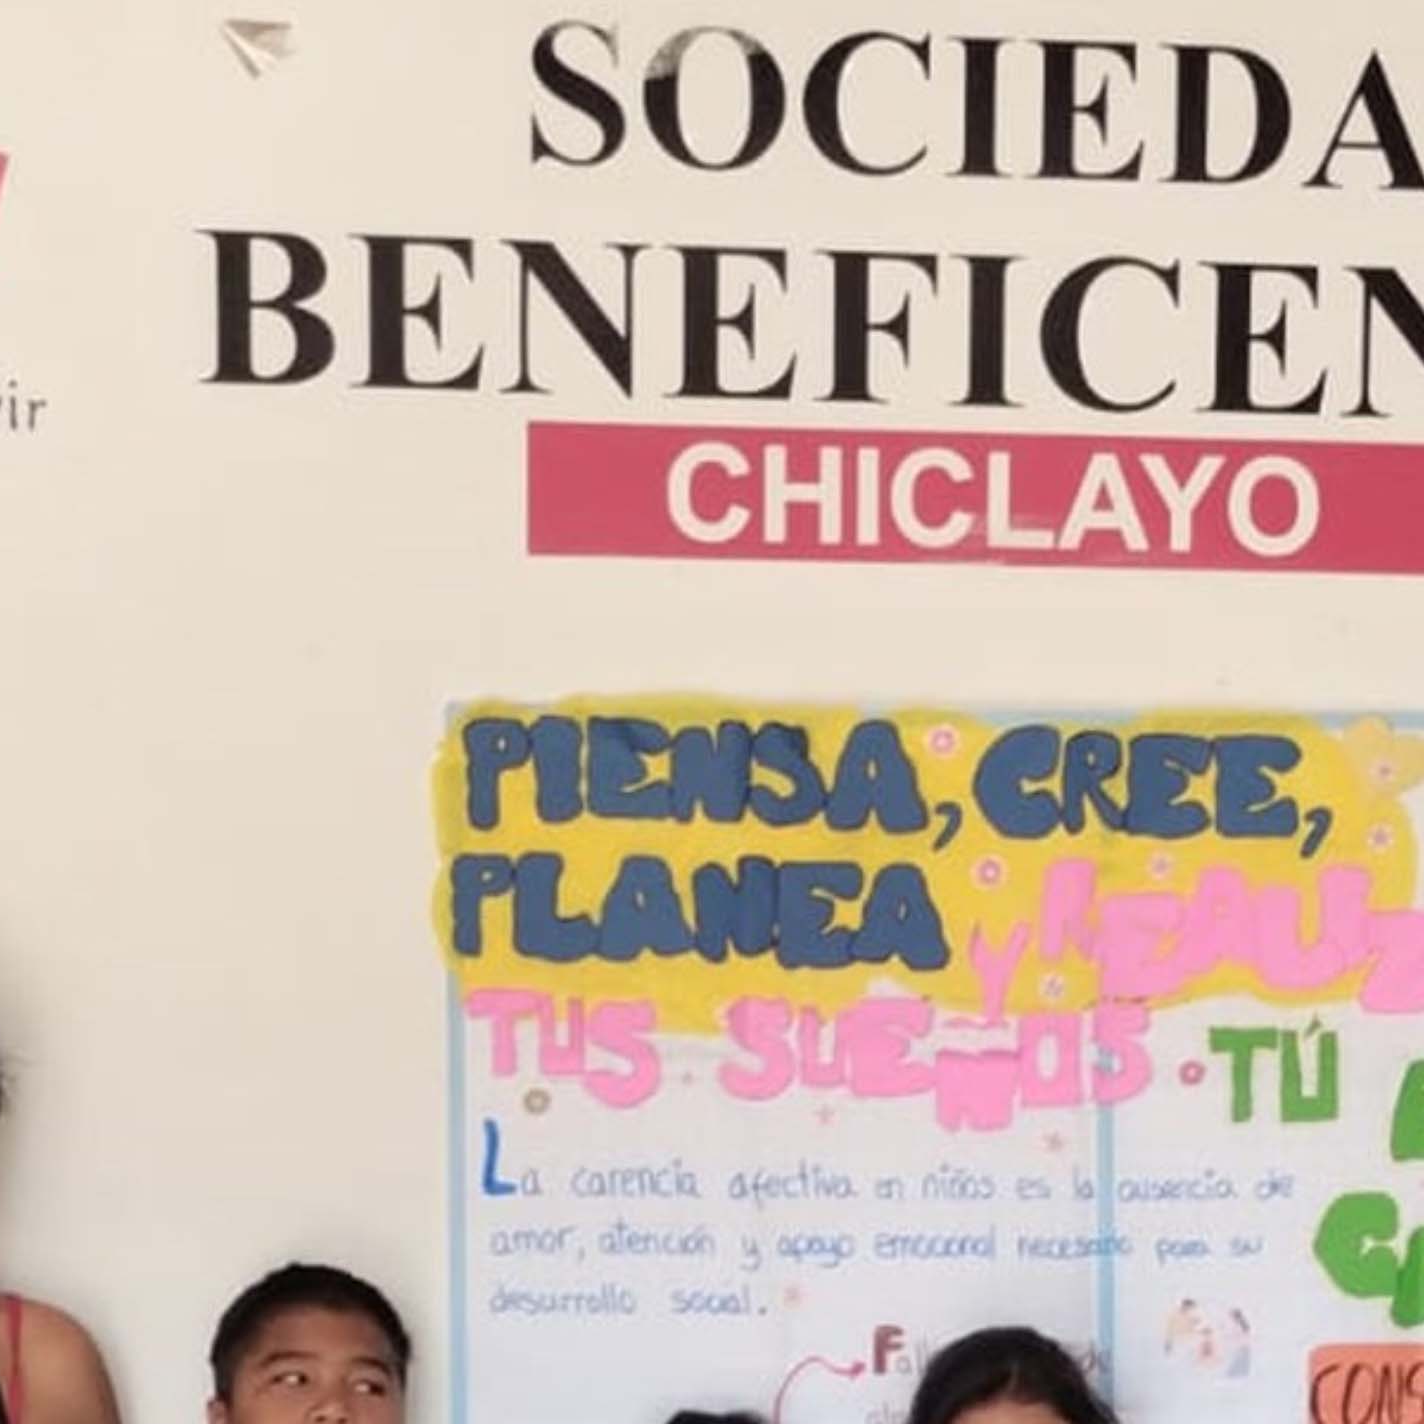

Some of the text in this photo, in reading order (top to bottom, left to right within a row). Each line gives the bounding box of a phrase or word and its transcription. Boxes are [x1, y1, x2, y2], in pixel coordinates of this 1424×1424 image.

[666, 440, 1320, 557] CHICLAYO
[462, 714, 1333, 858] PIENSA, CREE,
[449, 851, 950, 970] PLANEA
[463, 986, 662, 1109] TUS
[1208, 1013, 1339, 1122] TÚ
[483, 1119, 1295, 1206] La carencia afectiva en niños es la ausencia de
[490, 1225, 586, 1262] amor,
[598, 1217, 715, 1256] atención
[740, 1234, 762, 1271] y
